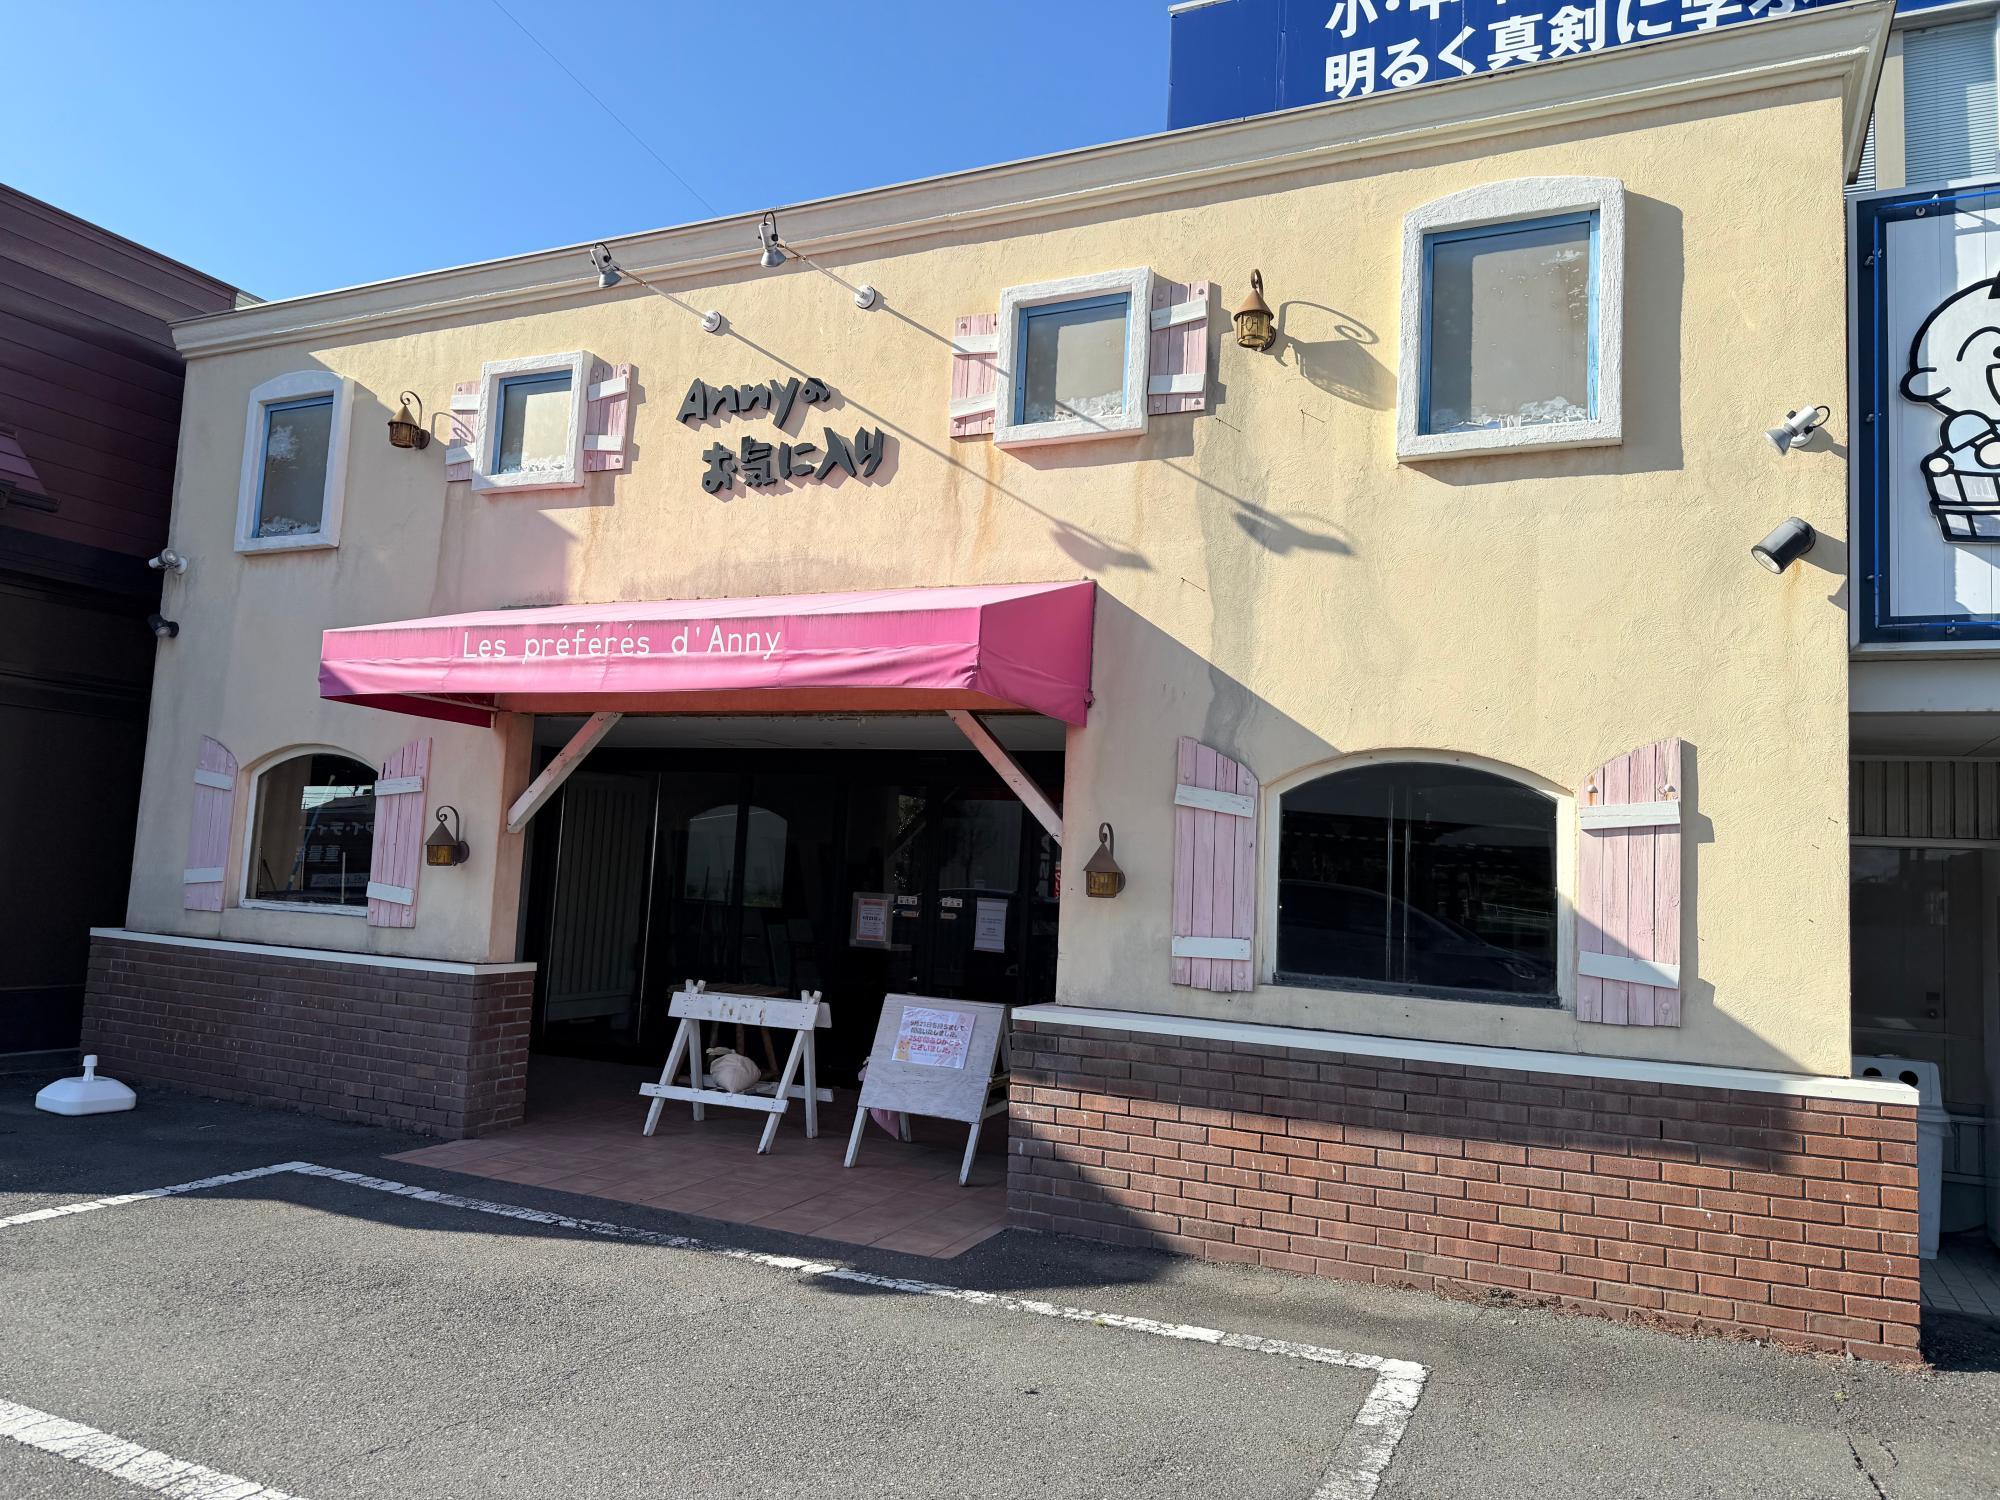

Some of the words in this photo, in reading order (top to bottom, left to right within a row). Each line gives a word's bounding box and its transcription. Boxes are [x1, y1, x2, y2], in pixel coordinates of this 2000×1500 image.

[702, 427, 884, 493] お気に入り
[463, 631, 506, 658] Les
[522, 624, 650, 664] préférés
[671, 624, 782, 660] d'Anny
